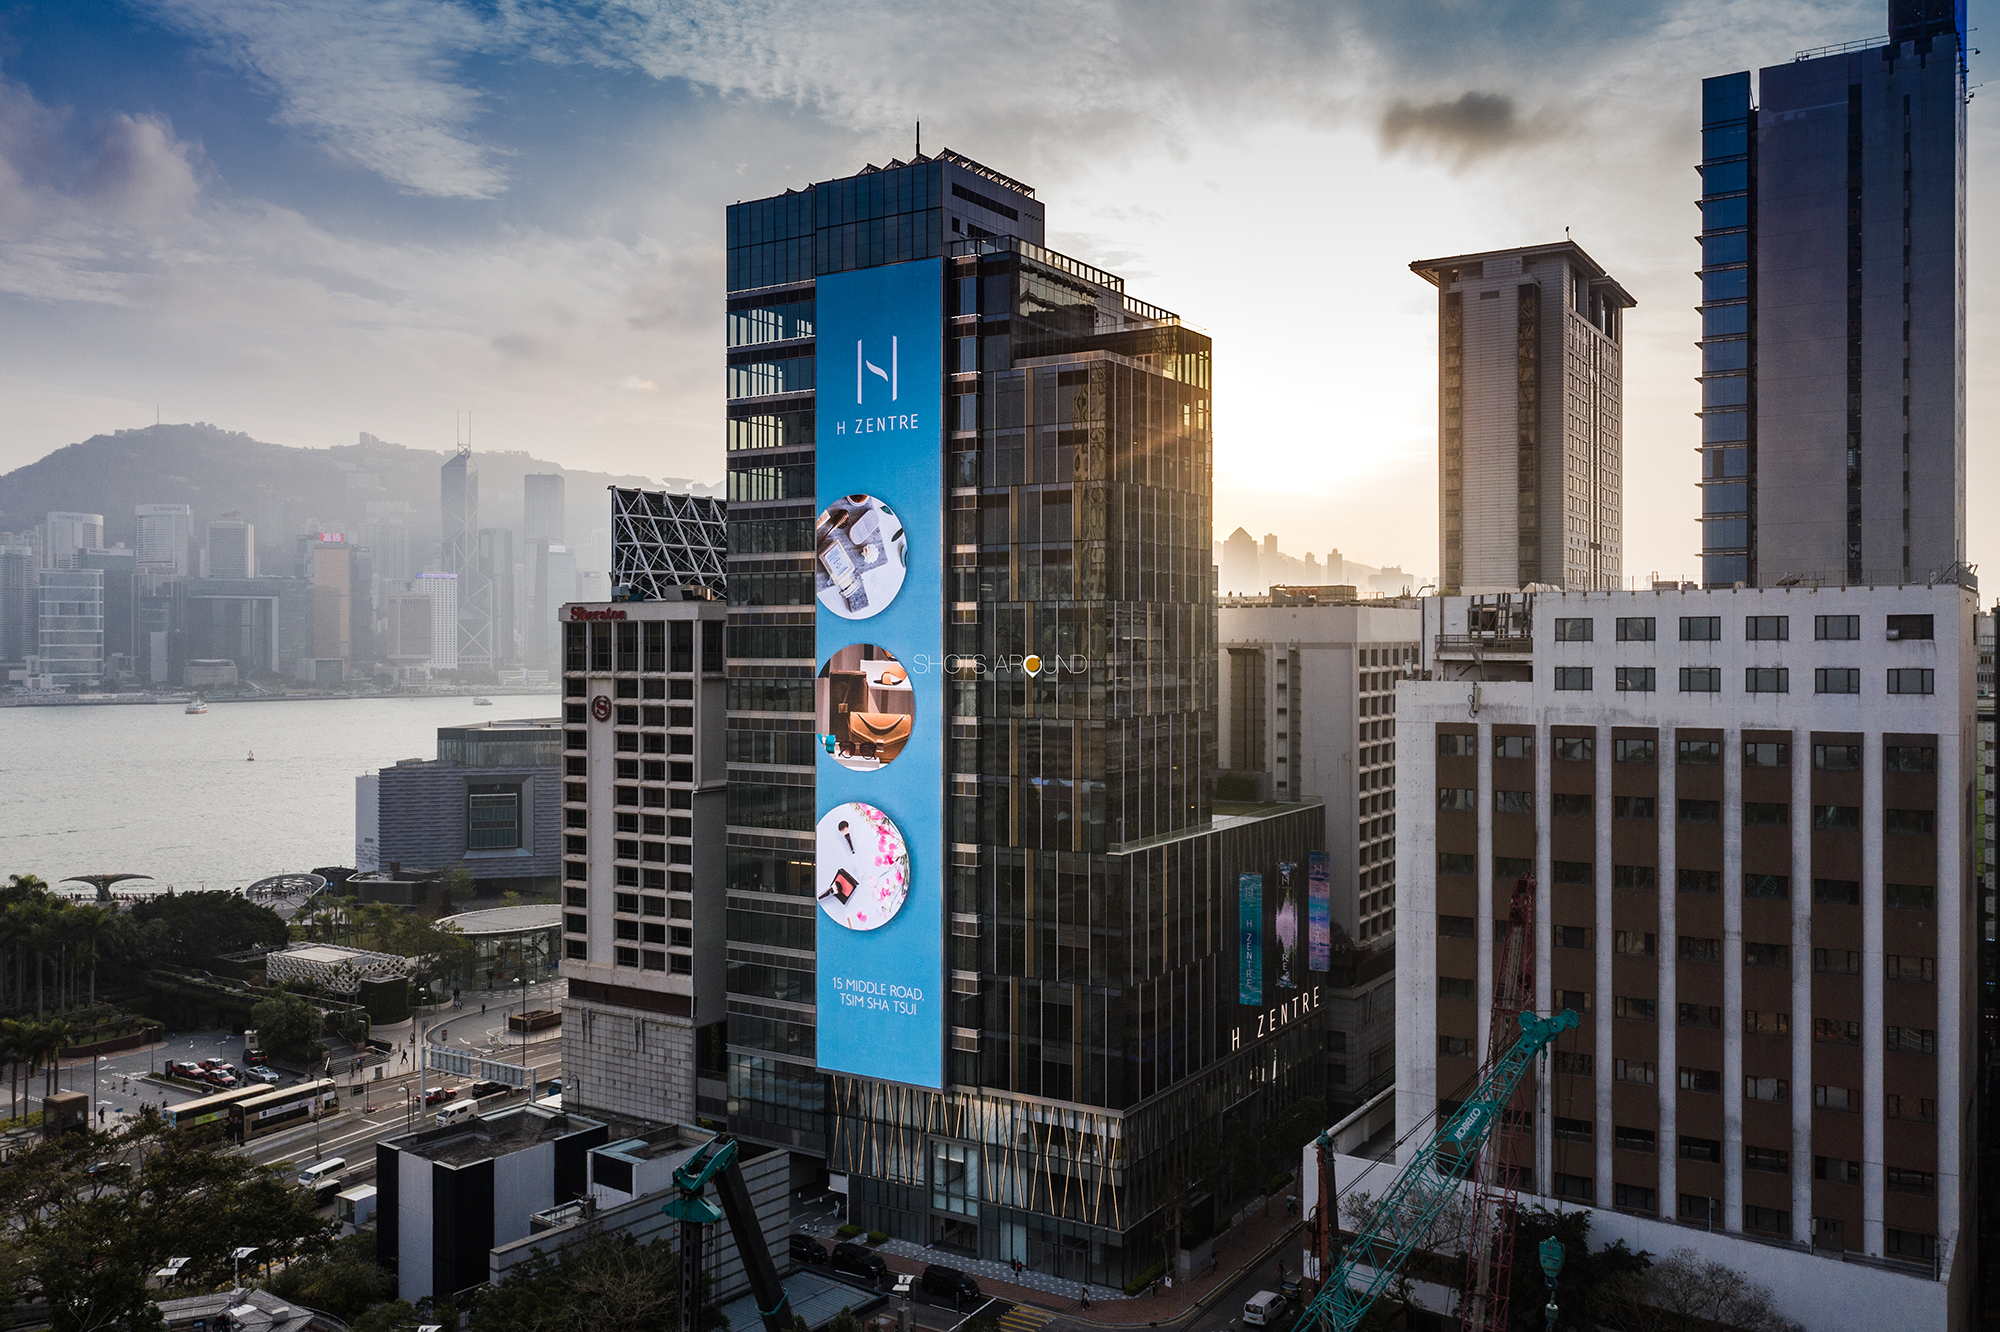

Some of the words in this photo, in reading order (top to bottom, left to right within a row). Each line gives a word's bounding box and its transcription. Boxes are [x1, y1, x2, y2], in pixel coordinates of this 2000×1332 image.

[837, 421, 846, 435] H
[855, 413, 919, 434] ZENTRE
[570, 606, 627, 621] Sheraton
[832, 977, 843, 989] 15
[846, 979, 887, 996] MIDDLE
[840, 992, 864, 1008] TSIM
[867, 996, 890, 1012] SHA
[892, 1000, 917, 1016] TSUI
[1232, 1026, 1240, 1052] H
[1257, 985, 1320, 1039] ZENTRE
[1453, 1107, 1481, 1141] KOBELCO
